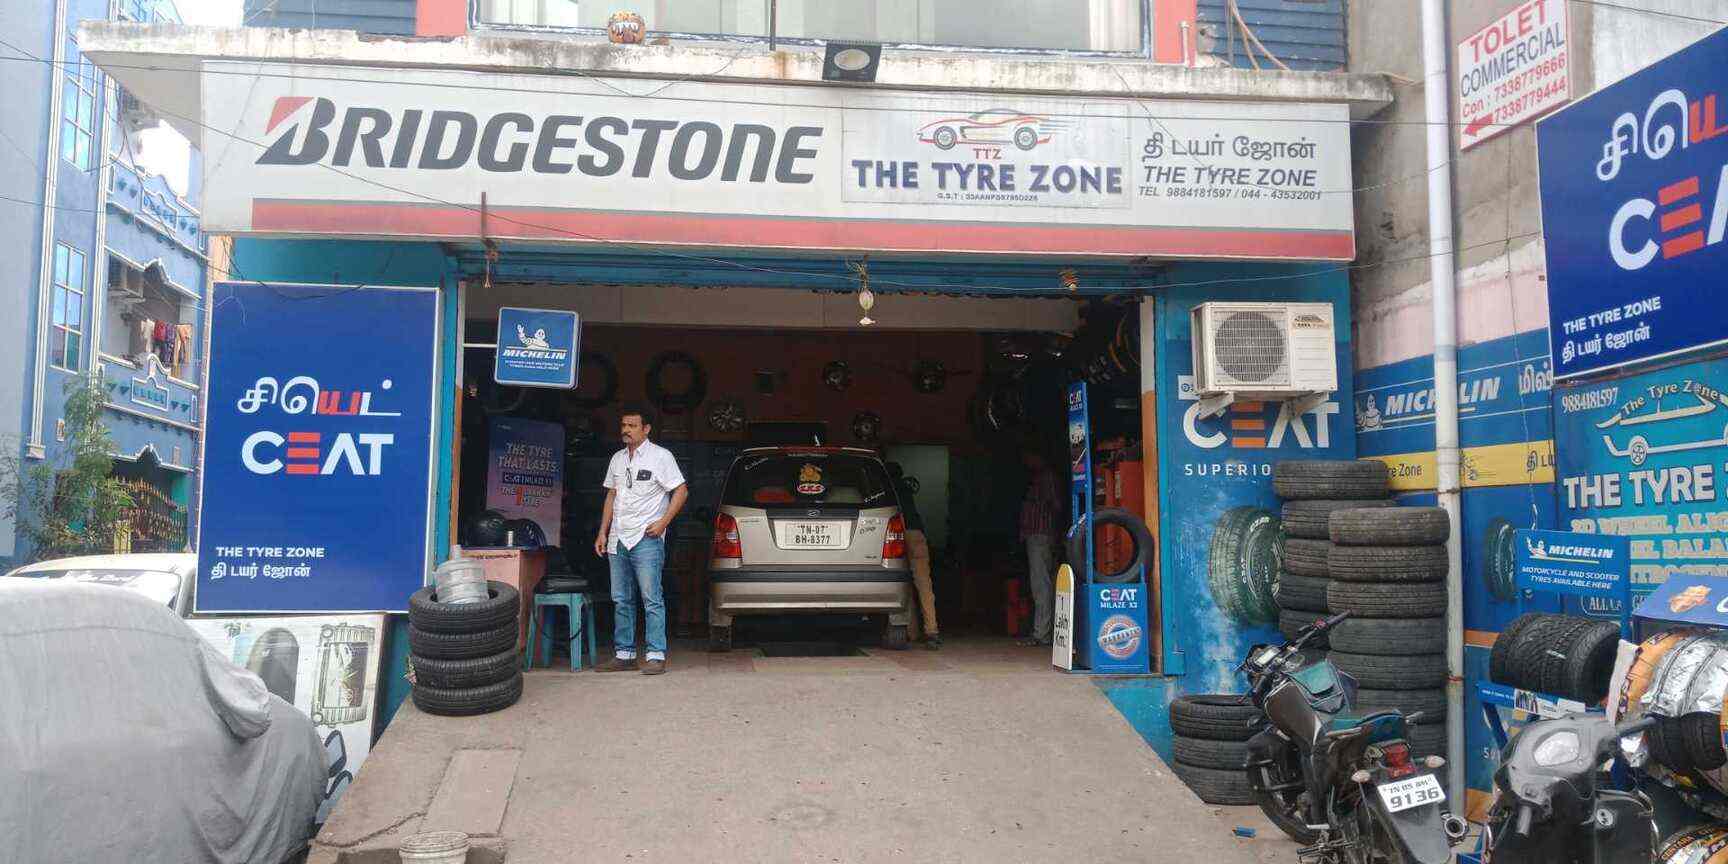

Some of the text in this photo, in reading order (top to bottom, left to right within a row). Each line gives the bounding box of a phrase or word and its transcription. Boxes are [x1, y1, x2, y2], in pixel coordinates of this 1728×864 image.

[1470, 0, 1548, 63] TOLET
[1461, 22, 1564, 97] COMMERCIAL
[1495, 52, 1566, 102] 7338779666
[1495, 76, 1566, 123] 7338779444
[254, 96, 824, 184] BRIDGESTONE
[973, 148, 1003, 160] TTZ
[1172, 133, 1225, 155] டயர்
[1232, 135, 1316, 162] ஜோன்
[851, 159, 1122, 194] THE TYRE ZONE
[1144, 165, 1317, 187] THE TYRE ZONE
[1139, 186, 1160, 197] TEL
[1167, 187, 1231, 198] 9884181597
[1241, 188, 1262, 199] 044
[1563, 296, 1662, 335] THE TYRE ZONE
[1578, 333, 1602, 355] டயர்
[1605, 321, 1650, 349] ஜோன்
[502, 349, 566, 360] MICHELIN
[237, 375, 401, 415] சியெட்
[1385, 377, 1501, 416] MICLIN
[1623, 396, 1645, 415] The
[1648, 383, 1680, 399] Tyre
[1183, 401, 1339, 448] CEAT
[241, 430, 394, 475] CEAT
[1184, 464, 1272, 476] SUPERIO
[1398, 463, 1422, 478] Zone
[1564, 473, 1621, 508] THE
[1629, 465, 1716, 504] TYRE
[216, 546, 325, 558] THE TYRE ZONE
[1548, 545, 1613, 558] MICHELIN
[210, 561, 312, 580] தி டயர் ஜோன்
[1522, 566, 1620, 580] MOTORCYCLE AND SCOOTER
[1531, 575, 1612, 590] TYRES AVAILABLE HERE
[1100, 588, 1137, 601] CEAT
[1390, 787, 1440, 808] 9136
